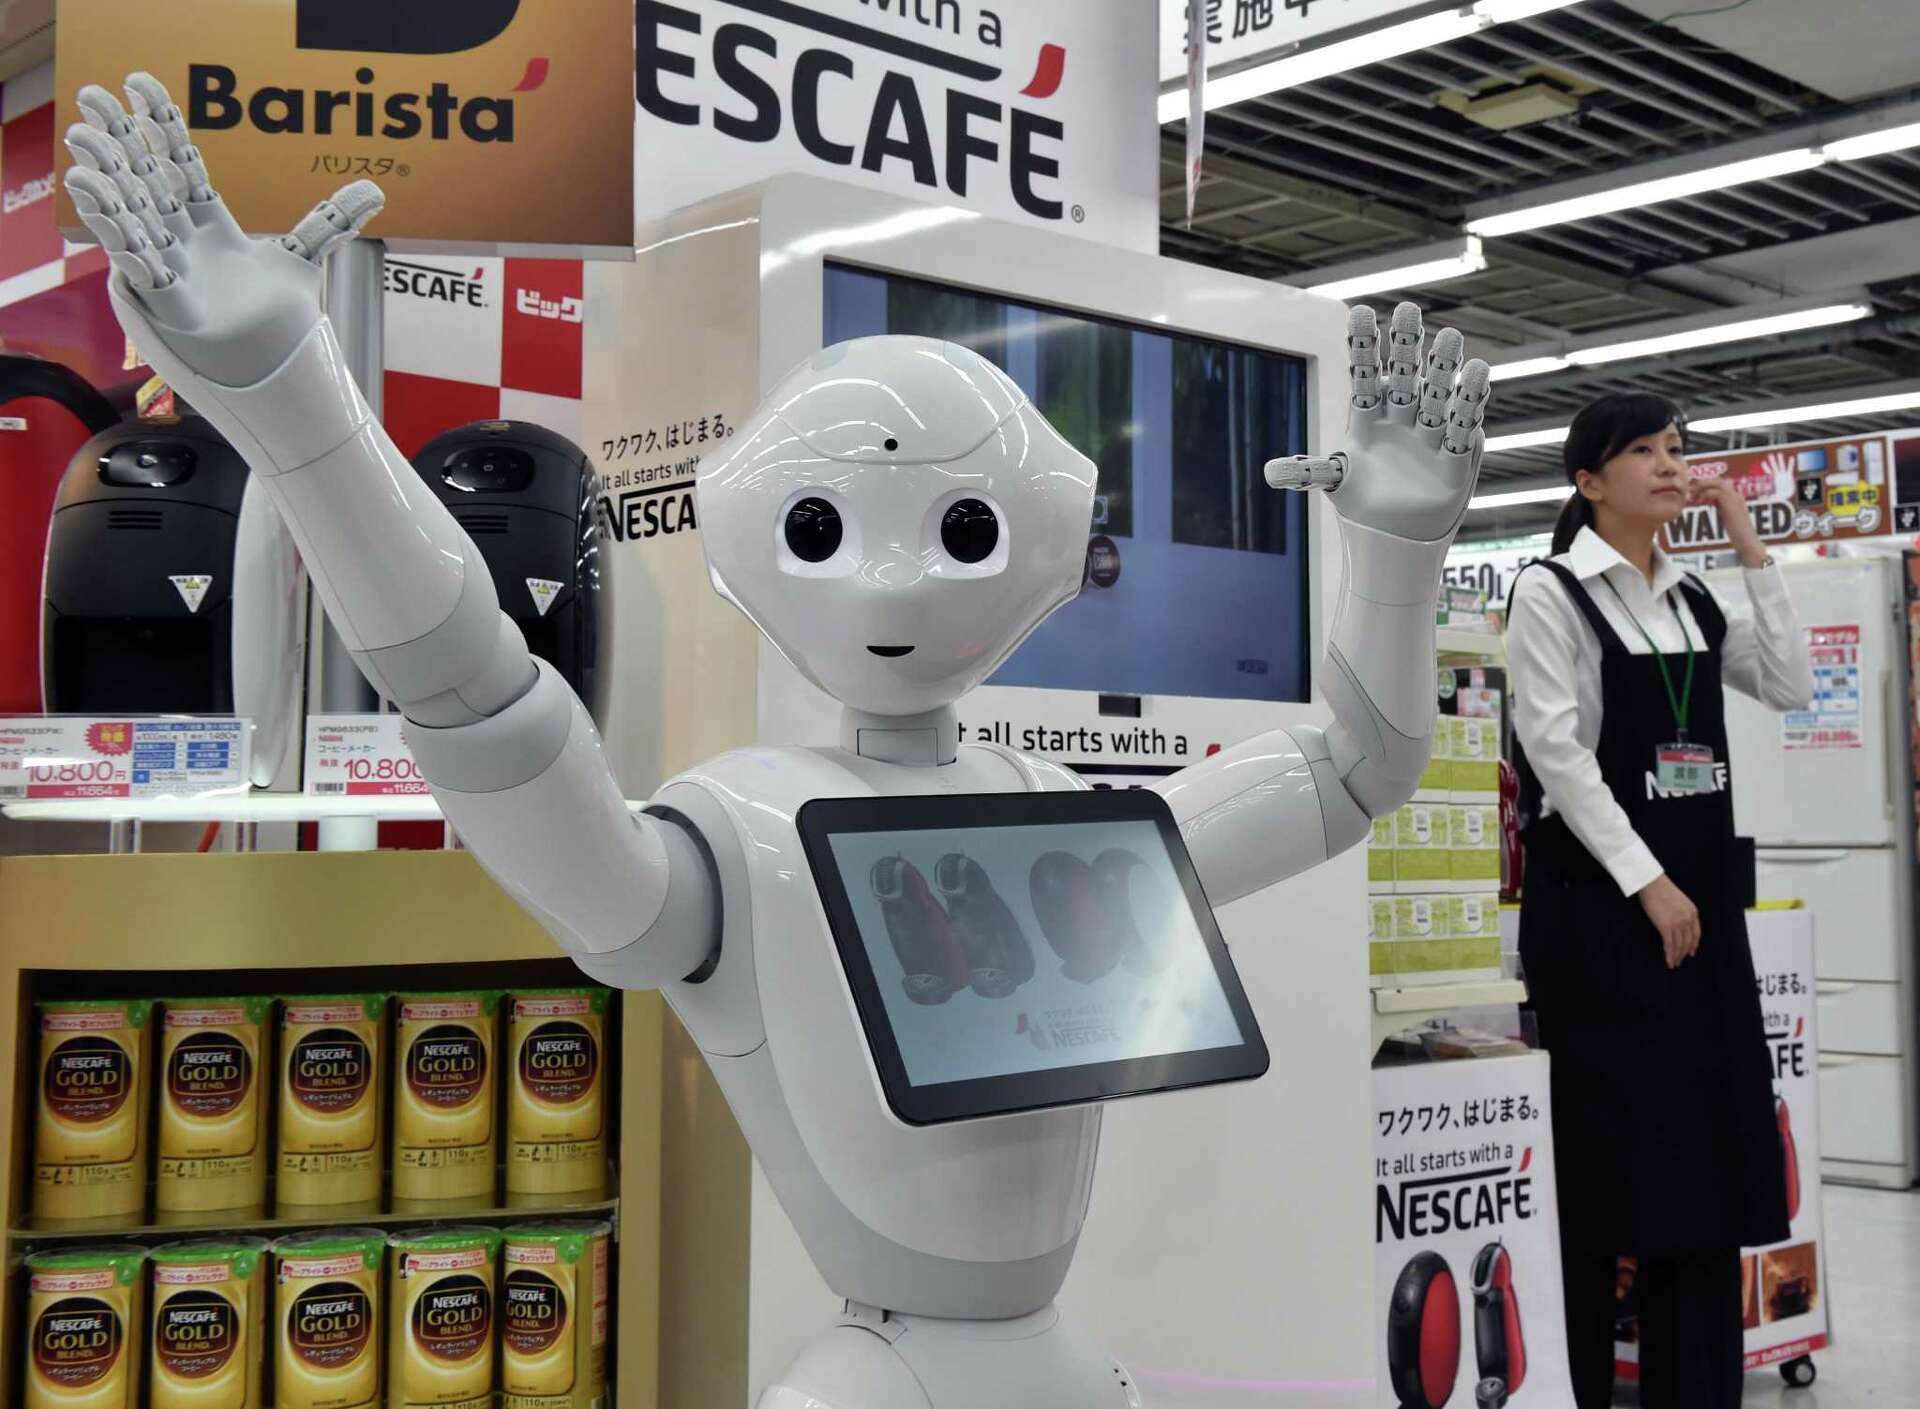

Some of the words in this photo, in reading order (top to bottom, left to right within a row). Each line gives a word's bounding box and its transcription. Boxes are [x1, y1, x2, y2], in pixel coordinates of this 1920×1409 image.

[978, 10, 1002, 48] a
[188, 63, 515, 143] Barista
[602, 413, 734, 461] ワクワク、はじまる。
[614, 468, 631, 486] all
[634, 463, 672, 485] starts
[600, 480, 698, 543] NESCA
[1668, 502, 1792, 546] WAED
[1023, 725, 1102, 752] starts
[1111, 727, 1166, 755] with
[1174, 735, 1188, 755] a
[343, 758, 422, 780] 10,80
[300, 1062, 359, 1078] GOLD
[418, 1057, 476, 1073] GOLD
[531, 1053, 586, 1069] GOLD
[56, 1070, 118, 1086] GOLD
[179, 1065, 238, 1081] GOLD
[430, 1073, 465, 1082] BLEND
[543, 1069, 576, 1078] BLEND
[68, 1087, 103, 1096] BLEND
[190, 1082, 225, 1091] BLEND
[312, 1078, 347, 1087] BLEND
[1378, 1095, 1539, 1137] ワクワク、はじまる。
[1376, 1157, 1388, 1177] It
[1393, 1152, 1415, 1175] all
[1420, 1149, 1466, 1172] starts
[1469, 1142, 1500, 1165] with
[1505, 1144, 1513, 1160] a
[1376, 1146, 1532, 1243] NESCAFÉ
[427, 1307, 483, 1326] GOLD
[506, 1301, 551, 1319] GOLD
[165, 1323, 225, 1341] GOLD
[300, 1313, 361, 1333] GOLD
[440, 1323, 473, 1336] BLEND
[513, 1318, 541, 1328] BLEND
[44, 1331, 109, 1350] GOLD
[175, 1341, 211, 1350] BLEND
[313, 1332, 349, 1343] BLEND
[56, 1349, 95, 1360] BLEND
